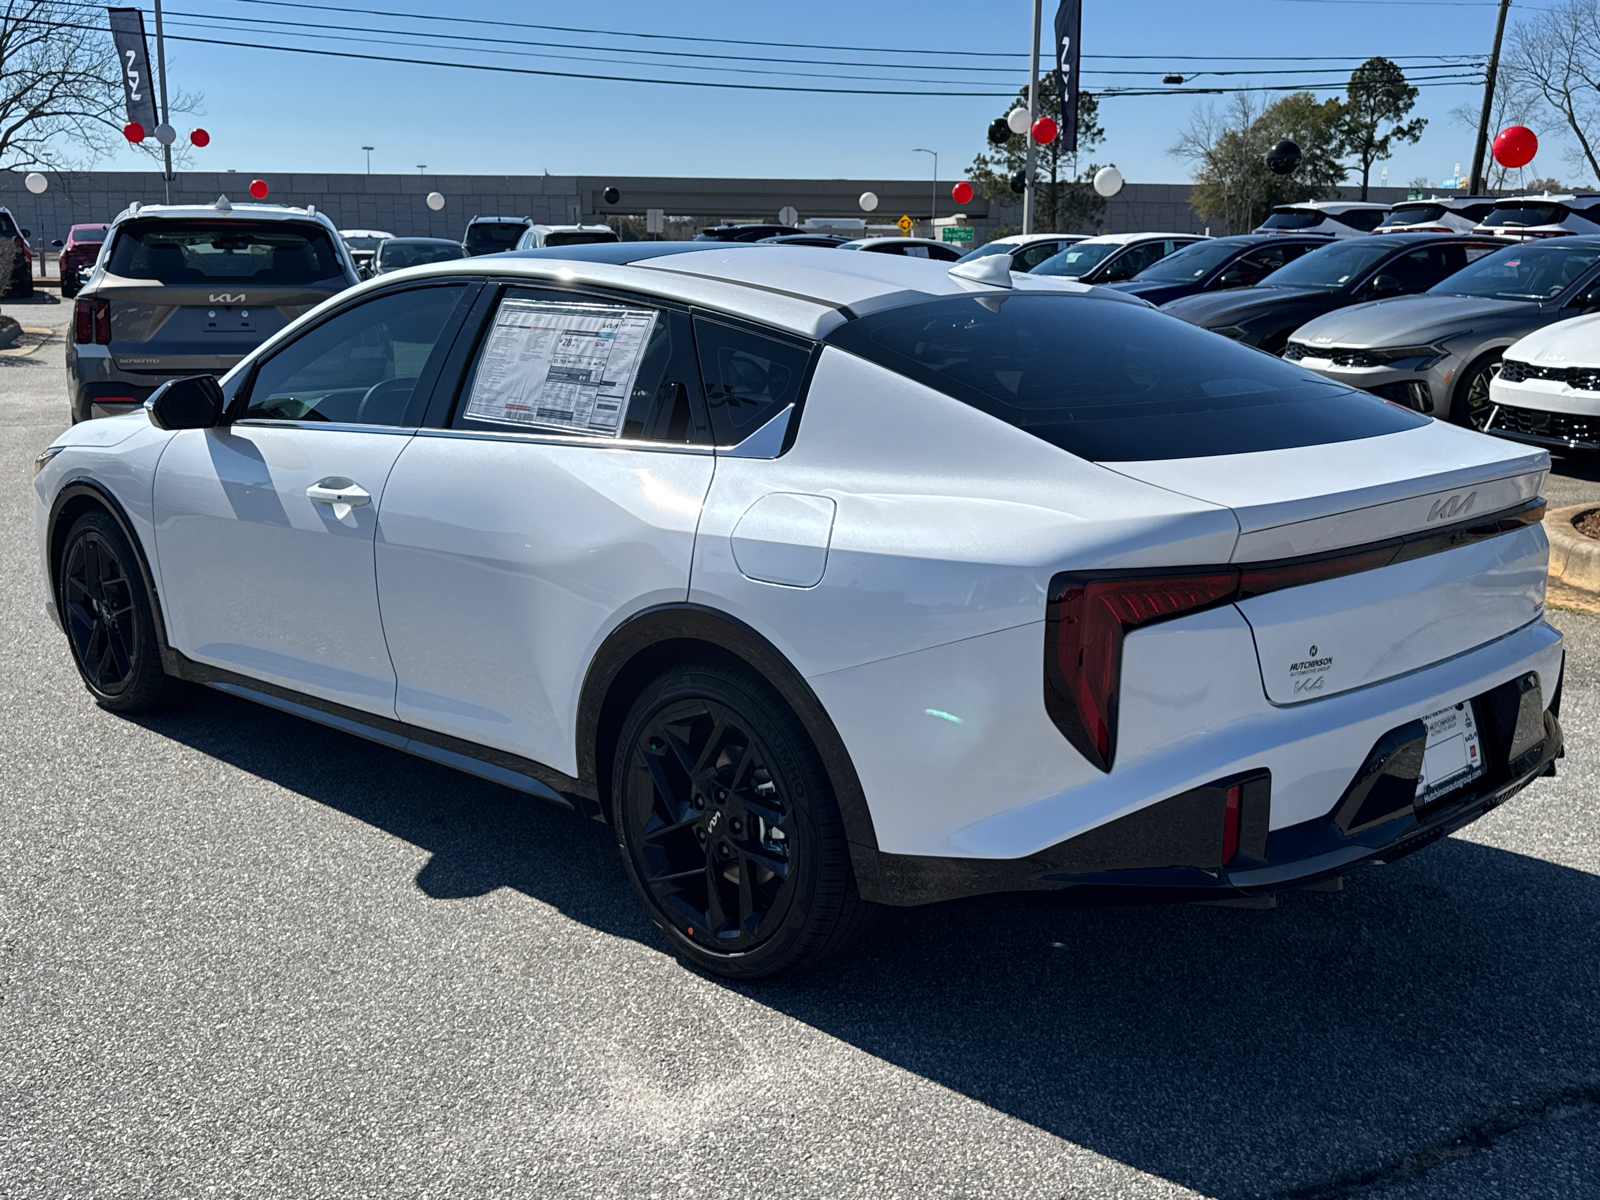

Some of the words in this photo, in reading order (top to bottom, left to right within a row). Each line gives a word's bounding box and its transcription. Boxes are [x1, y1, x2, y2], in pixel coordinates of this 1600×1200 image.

[209, 293, 246, 303] KIA
[1427, 491, 1478, 522] KIA
[1289, 656, 1334, 672] HUTCHINSON
[1290, 668, 1317, 677] AUTOMOTIVE
[1317, 665, 1331, 673] GROUP
[1294, 676, 1325, 694] K4
